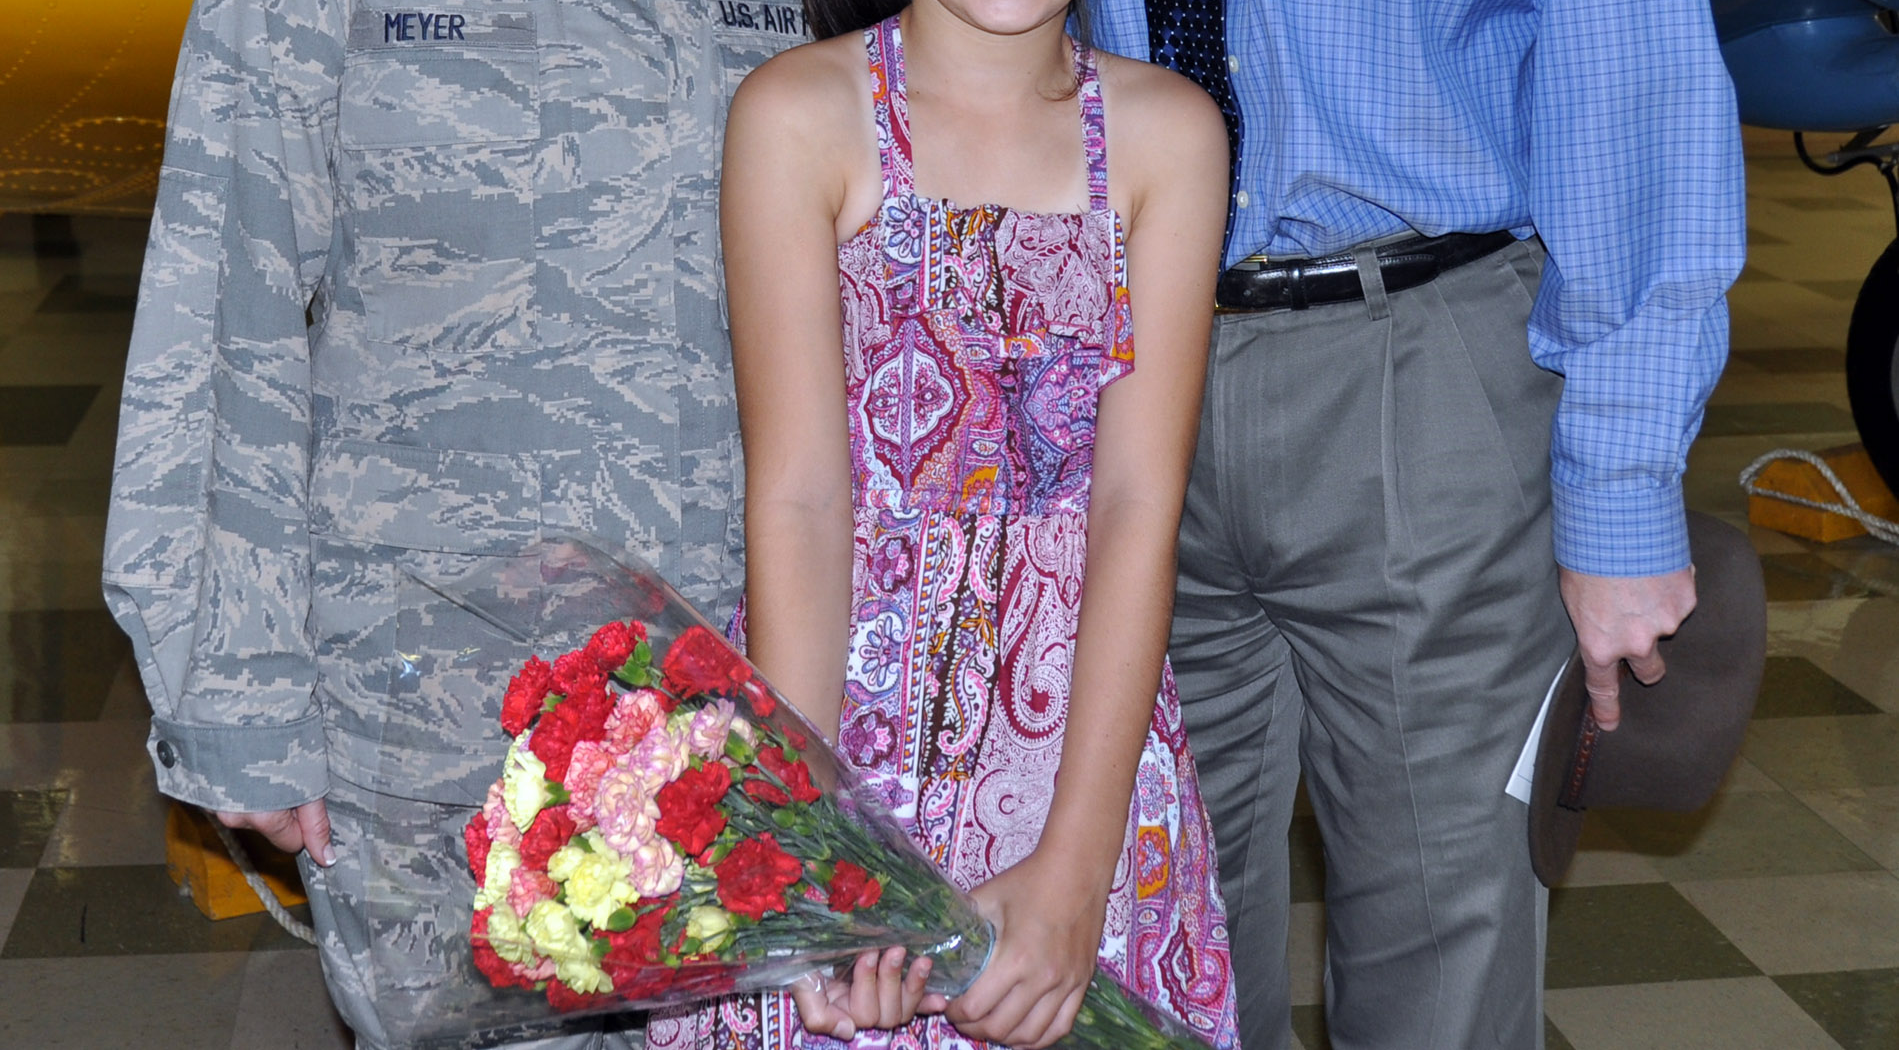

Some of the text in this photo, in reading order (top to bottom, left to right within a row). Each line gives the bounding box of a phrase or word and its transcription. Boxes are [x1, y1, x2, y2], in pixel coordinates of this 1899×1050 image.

[384, 12, 466, 43] MEYER
[718, 0, 760, 31] U.S.
[763, 3, 797, 35] AIR
